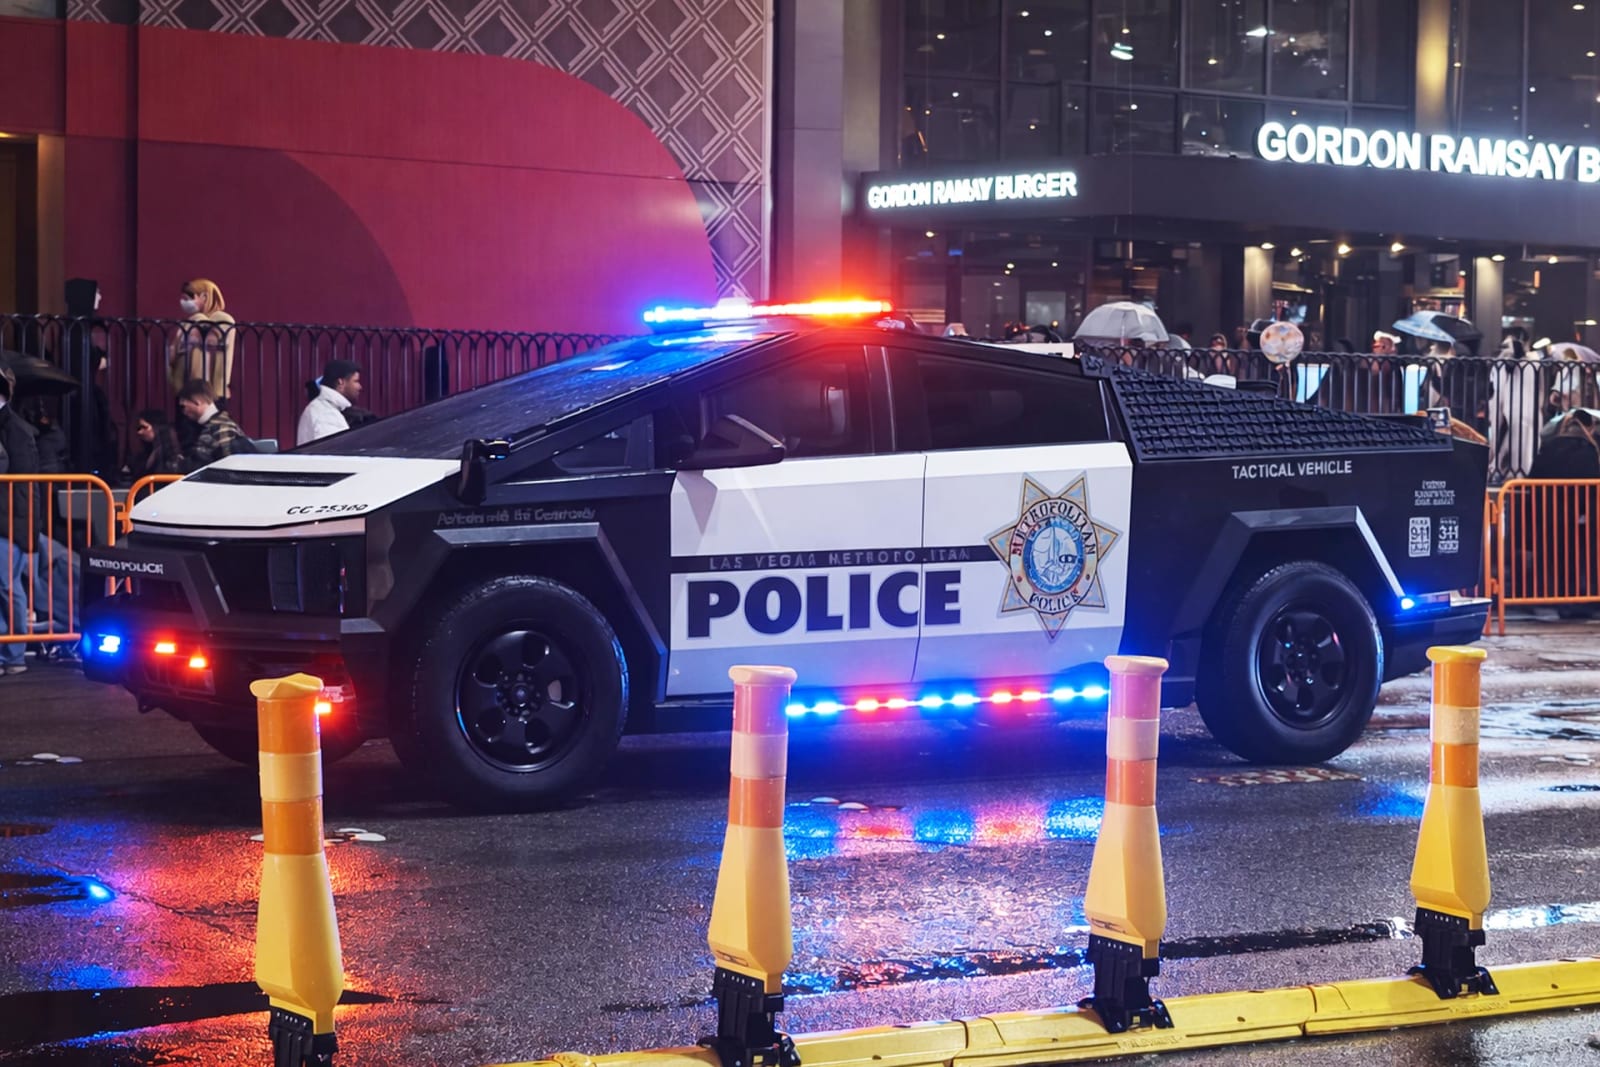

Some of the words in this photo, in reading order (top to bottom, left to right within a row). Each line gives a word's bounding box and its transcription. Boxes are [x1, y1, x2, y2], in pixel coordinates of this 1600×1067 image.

[1257, 121, 1421, 170] GORDON
[1430, 134, 1574, 180] RAMSAY
[868, 180, 931, 209] GORDON
[995, 171, 1078, 201] BURGER
[1232, 462, 1295, 479] TACTICAL
[1297, 460, 1353, 476] VEHICLE
[287, 505, 314, 515] CC
[709, 557, 743, 571] LAS
[686, 570, 962, 638] POLICE
